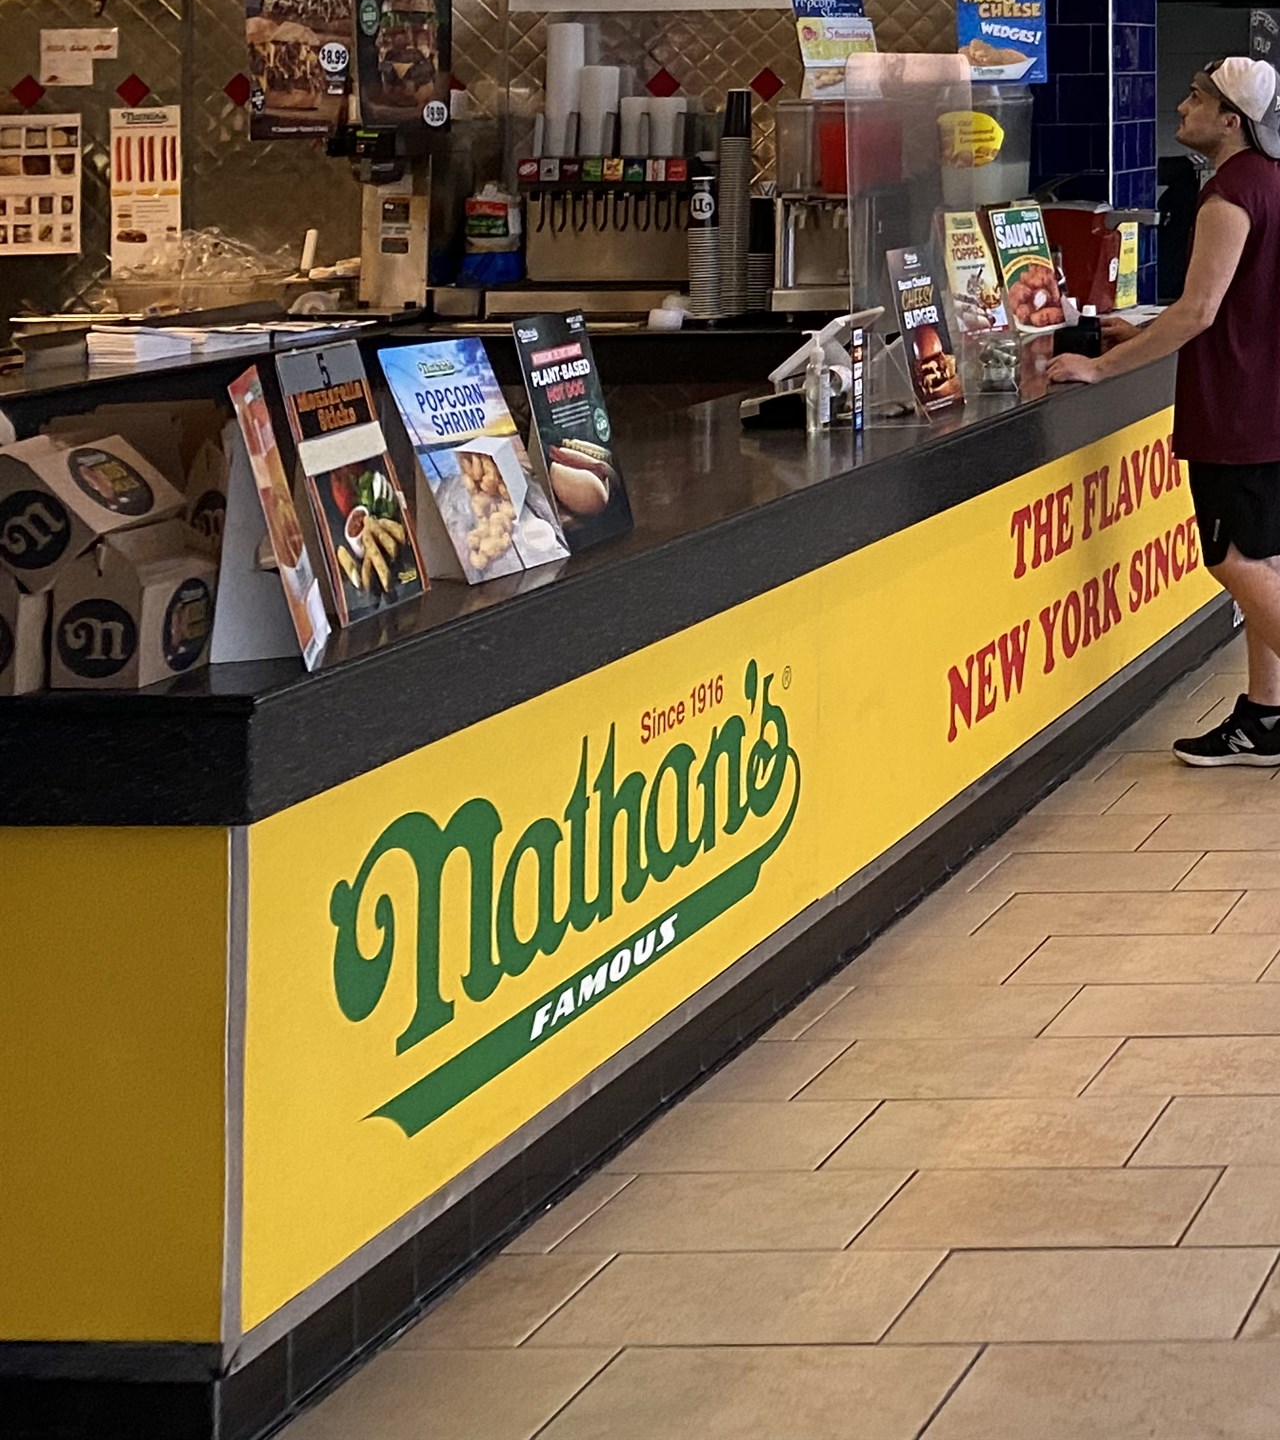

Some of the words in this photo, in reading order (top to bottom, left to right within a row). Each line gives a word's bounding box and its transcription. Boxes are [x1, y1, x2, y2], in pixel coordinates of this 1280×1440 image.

[978, 1, 1042, 18] CHEESE
[980, 21, 1042, 45] WEDGES!
[320, 48, 348, 65] $8.99
[992, 212, 1007, 226] GET
[995, 221, 1044, 250] SAUCY!
[951, 245, 985, 261] TOPPERS
[901, 284, 934, 311] CHEESY
[903, 305, 939, 330] BURGER
[530, 358, 591, 388] PLANT-BASED
[415, 383, 485, 414] POPCORN
[545, 382, 567, 404] HOT
[566, 379, 586, 398] DOG
[431, 407, 486, 436] SHRIMP
[1010, 483, 1074, 579] THE
[1081, 434, 1181, 540] FLAVOR
[947, 619, 1031, 743] NEW
[1039, 563, 1121, 675] YORK
[1128, 515, 1199, 613] SINCE
[641, 707, 685, 744] Since
[690, 674, 723, 717] 1916
[329, 659, 794, 1056] Nathan's
[529, 913, 678, 1042] FAMOUS
